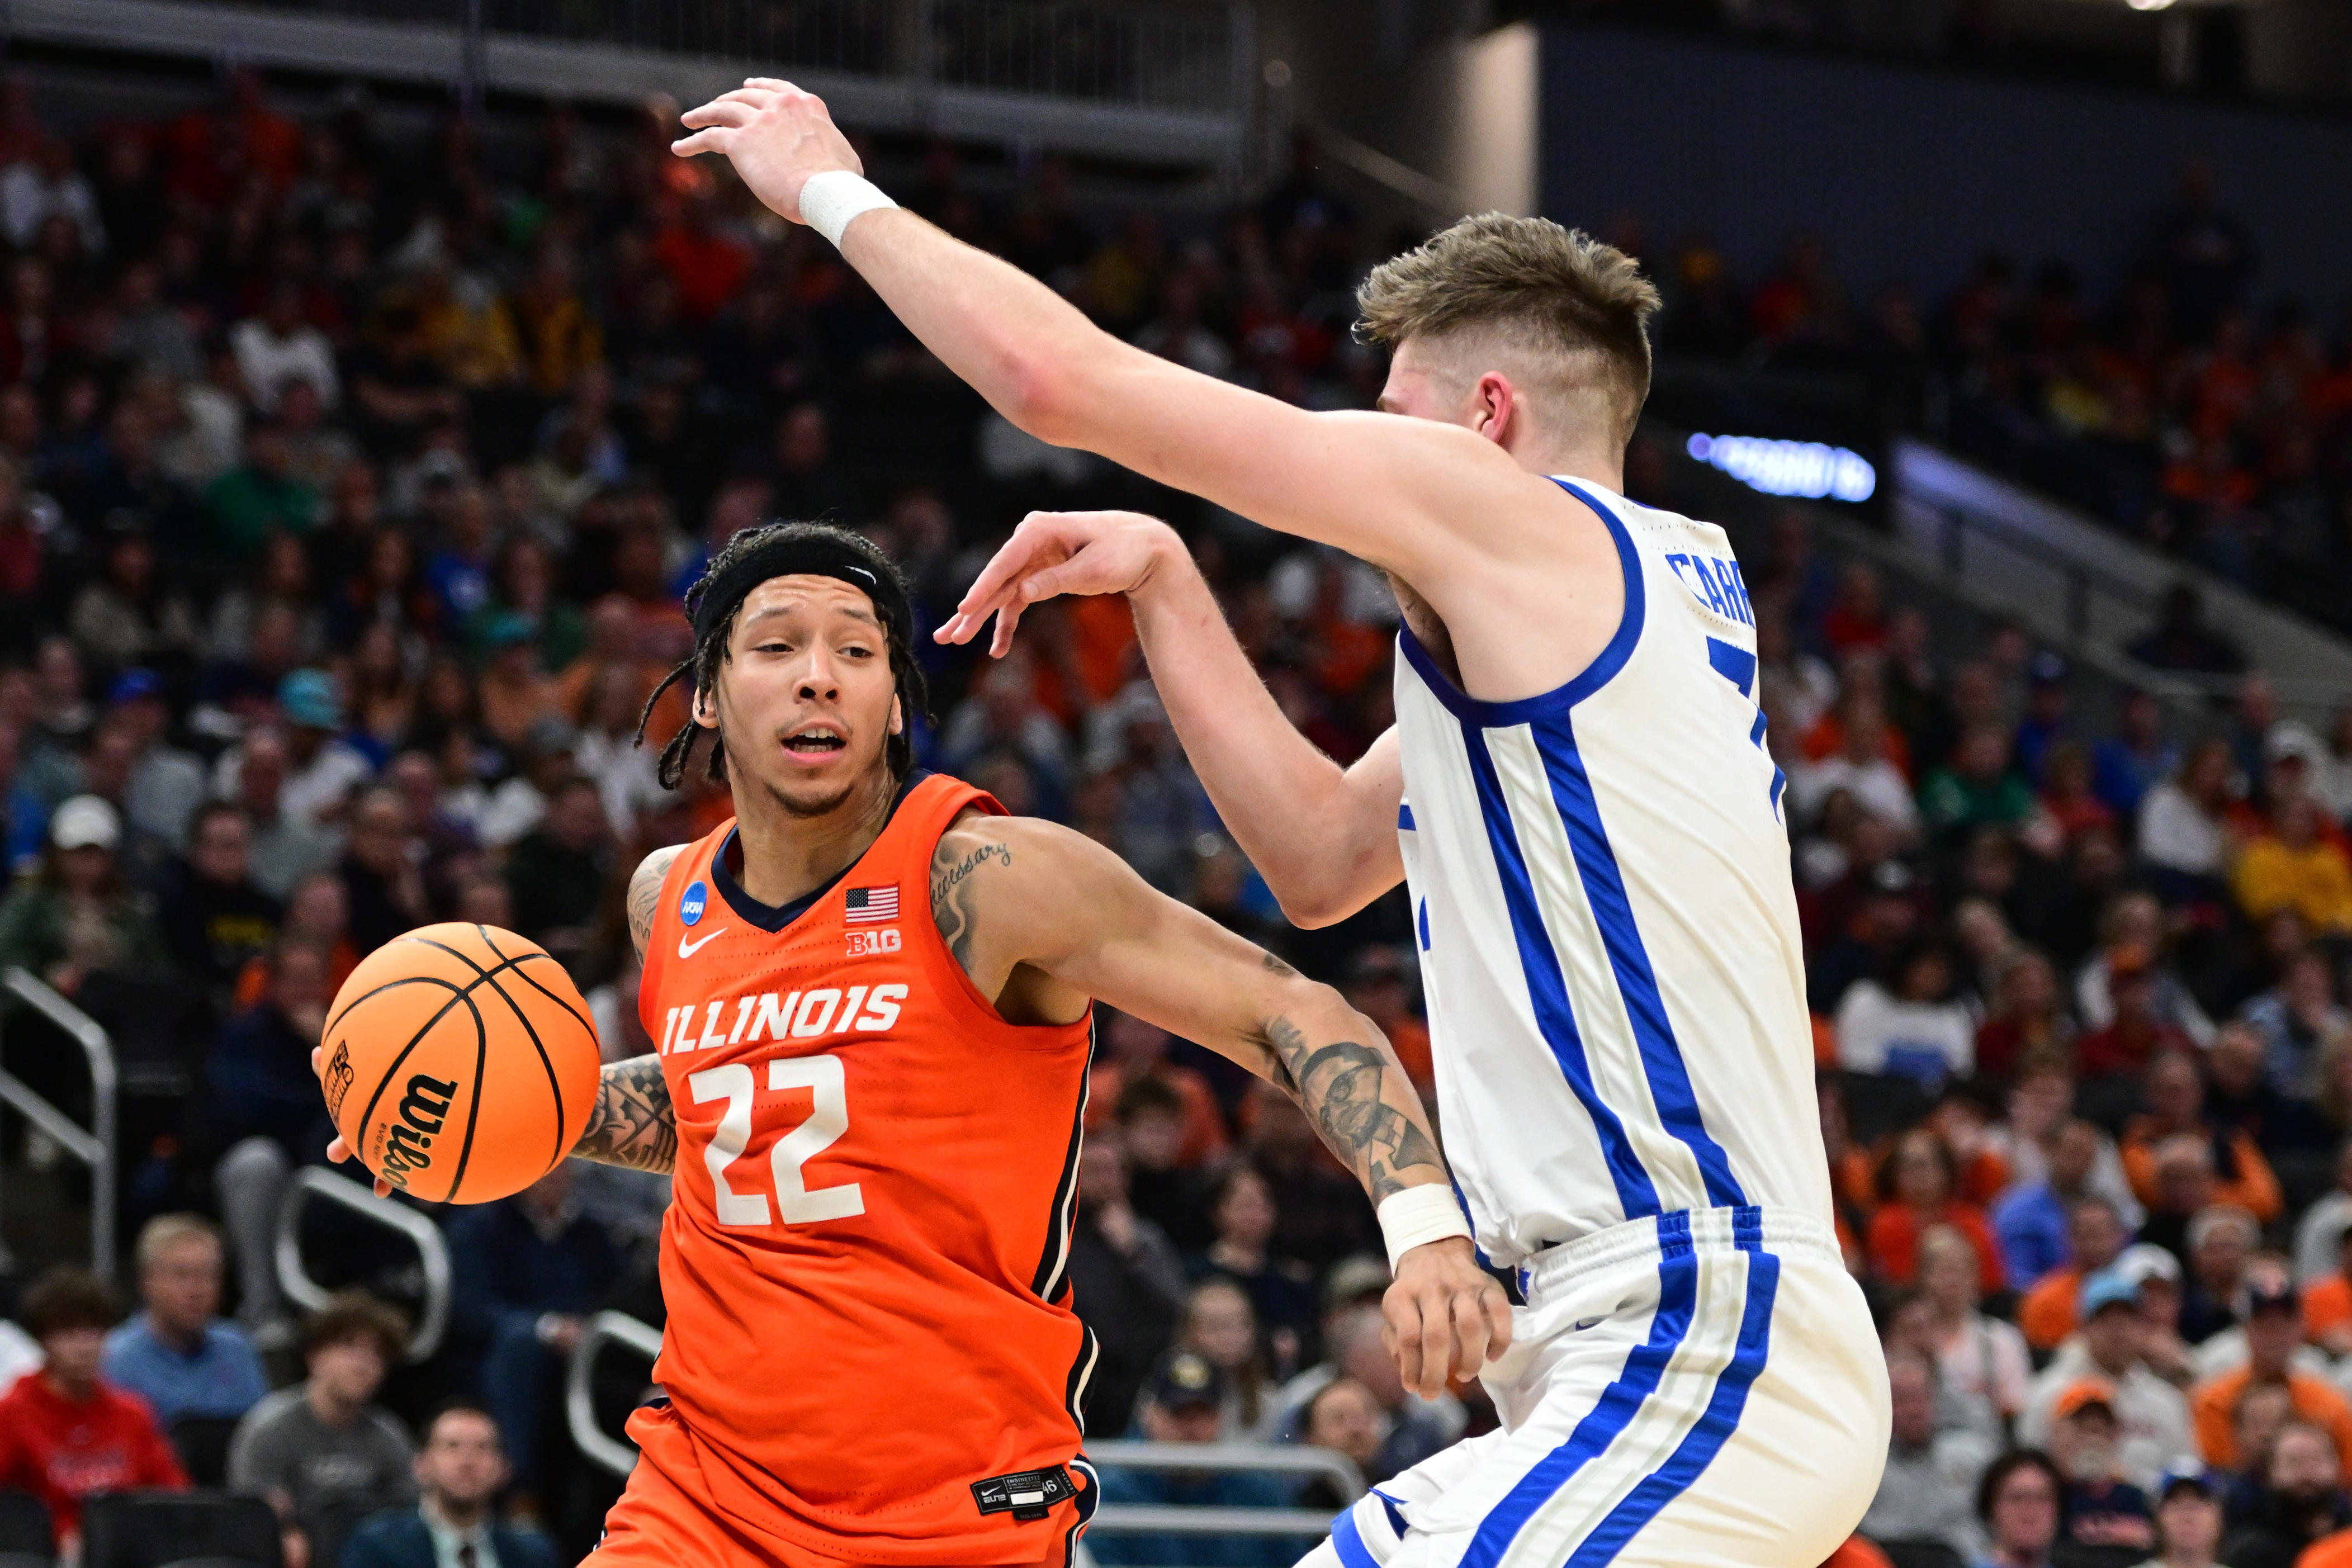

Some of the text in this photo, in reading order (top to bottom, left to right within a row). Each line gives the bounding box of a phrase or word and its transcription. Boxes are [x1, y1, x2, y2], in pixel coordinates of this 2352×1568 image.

[682, 901, 704, 914] NCAA
[662, 984, 908, 1056] ILLINOIS
[688, 1054, 865, 1226] 22
[1042, 1480, 1057, 1494] 46
